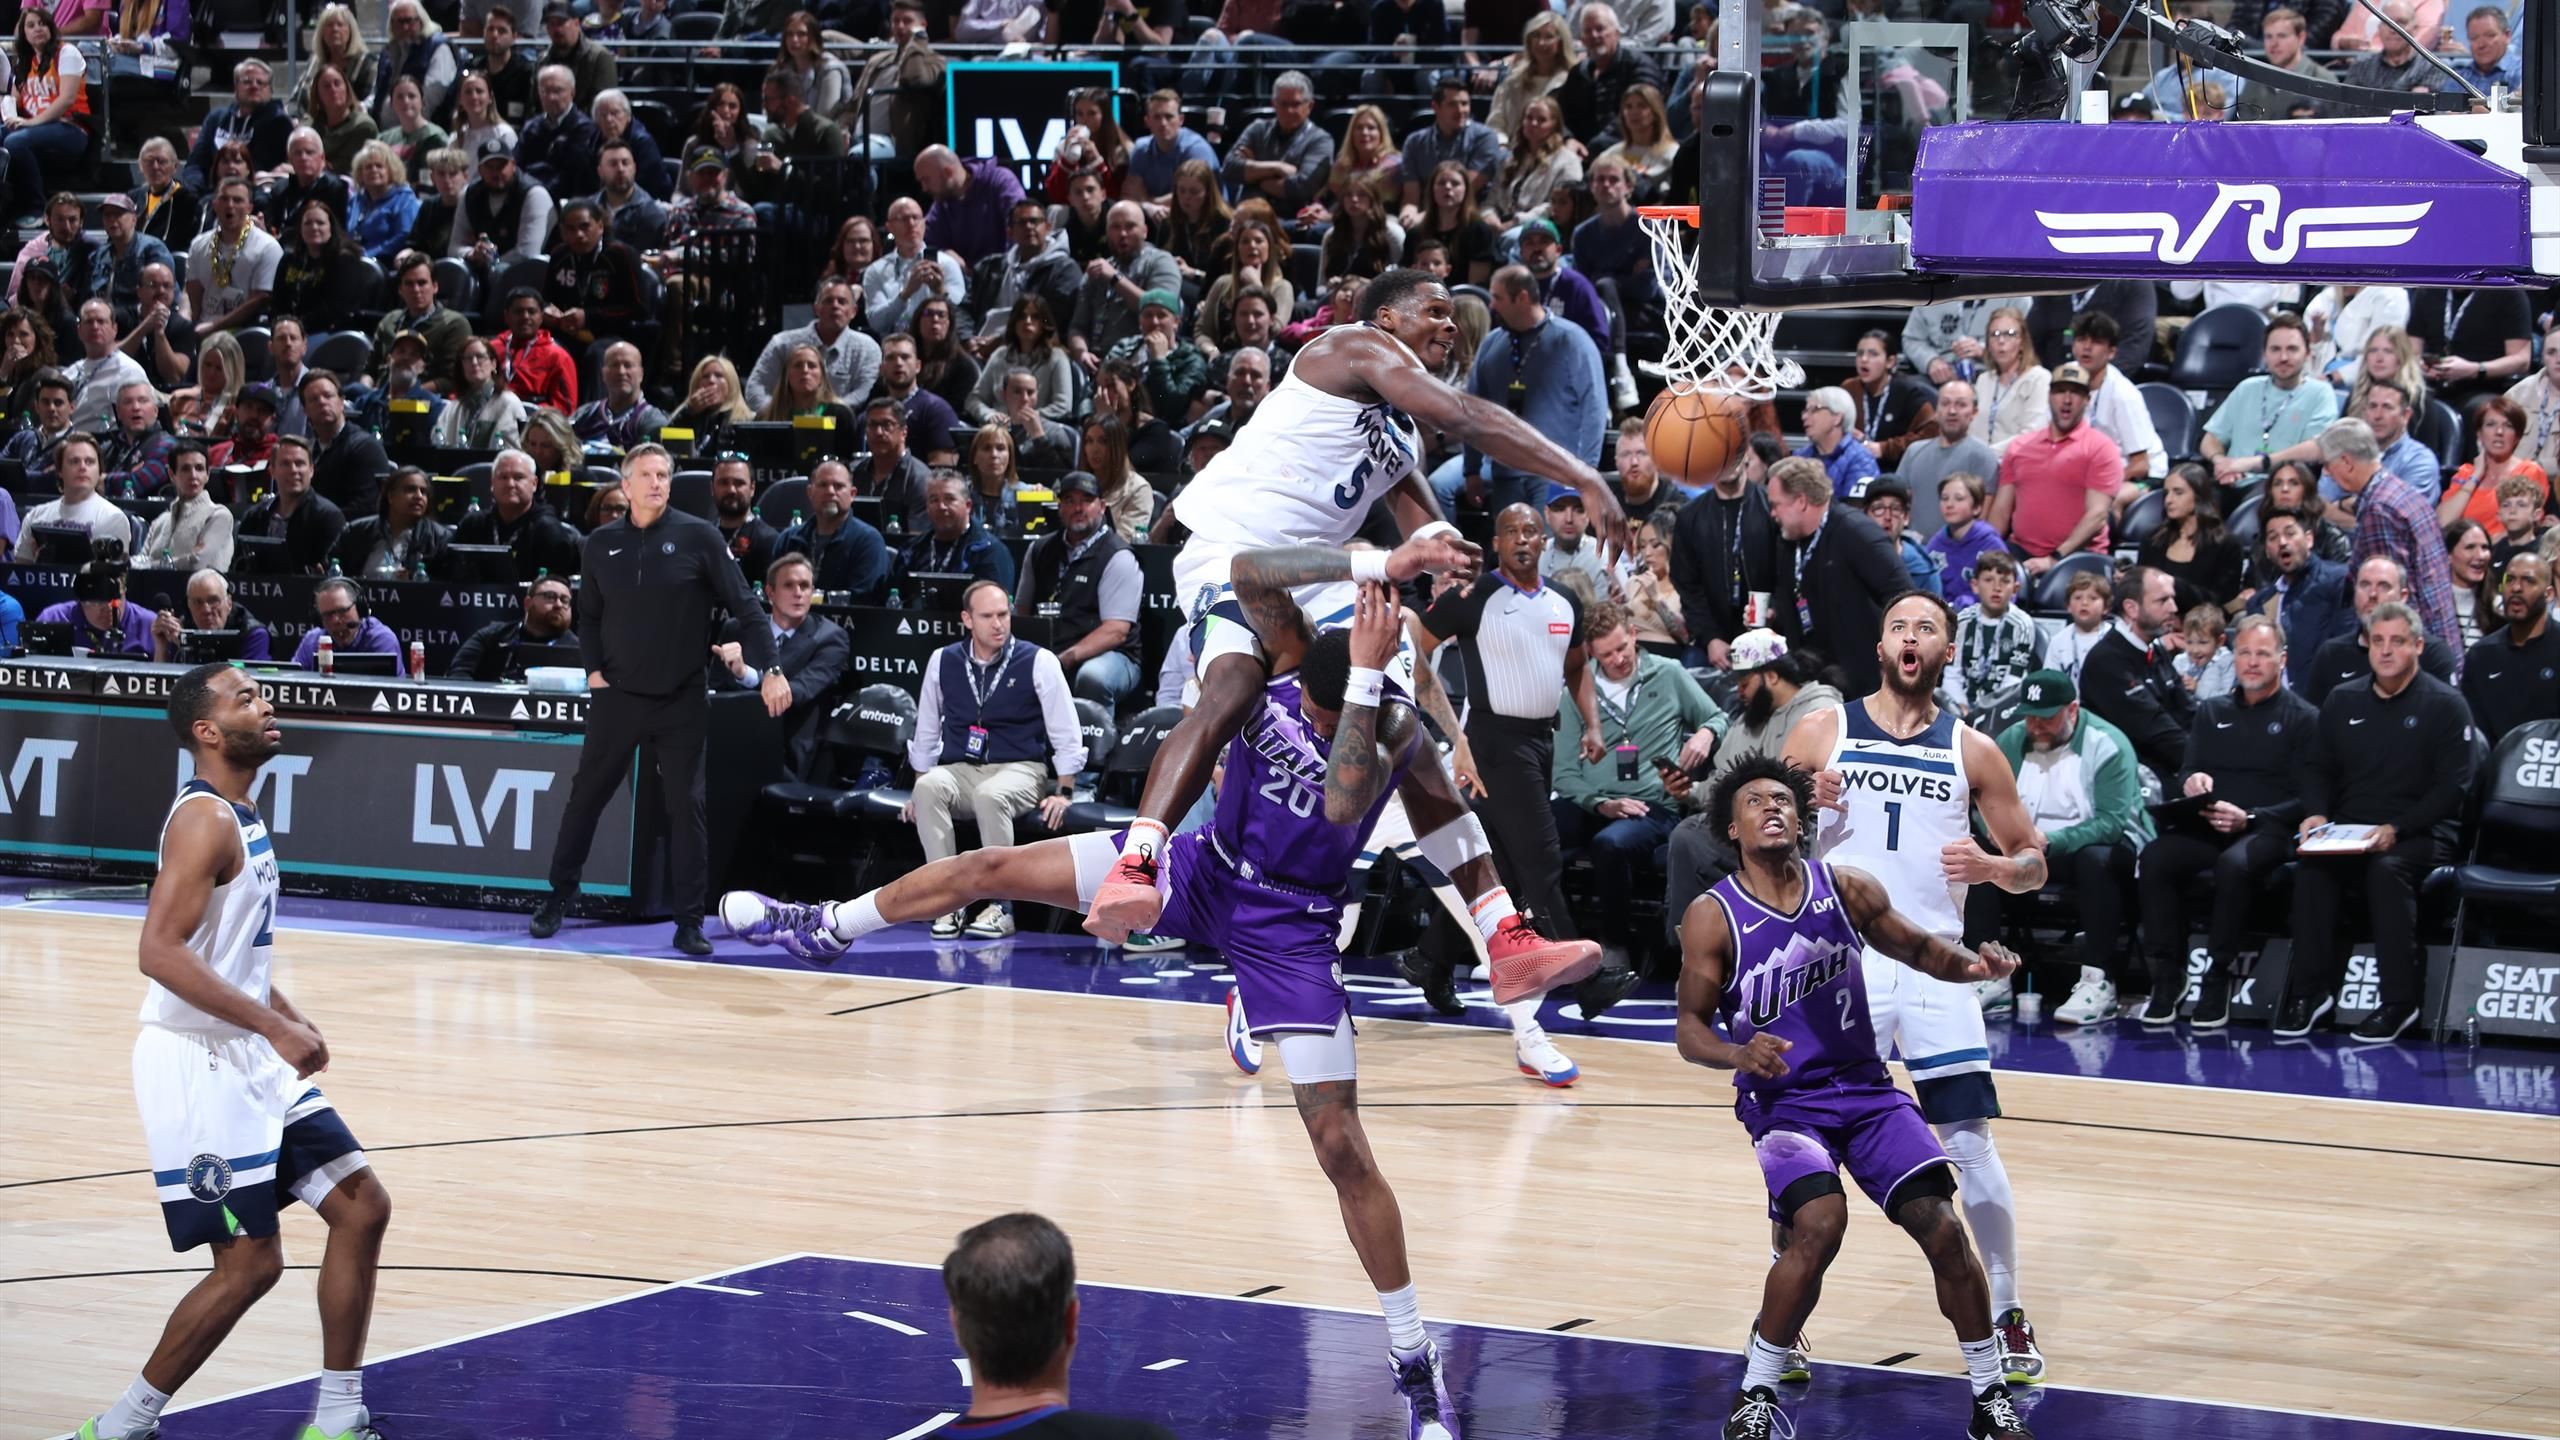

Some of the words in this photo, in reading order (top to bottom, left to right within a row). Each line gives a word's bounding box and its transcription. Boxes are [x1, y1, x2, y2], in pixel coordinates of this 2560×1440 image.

[556, 268, 576, 287] 45
[757, 468, 800, 481] ELTA
[1334, 456, 1374, 510] 5
[460, 591, 520, 609] DELTA
[402, 629, 461, 645] DELTA
[917, 618, 966, 637] DELT
[855, 655, 919, 675] DELTA
[0, 669, 71, 690] DELTA
[127, 676, 172, 696] DEL
[261, 684, 337, 707] DELTA
[397, 692, 475, 715] DELTA
[537, 699, 585, 722] DEL
[860, 708, 905, 726] entrata
[1259, 765, 1318, 819] 20
[1842, 769, 1953, 802] WOLVES
[412, 762, 556, 850] LVT
[1884, 801, 1902, 852] 1
[1811, 896, 1835, 915] LVT
[2344, 955, 2380, 983] SE
[2484, 962, 2560, 994] SEAT
[1749, 943, 1852, 1028] UTAH
[1835, 987, 1856, 1031] 2
[2476, 991, 2559, 1024] GEEK
